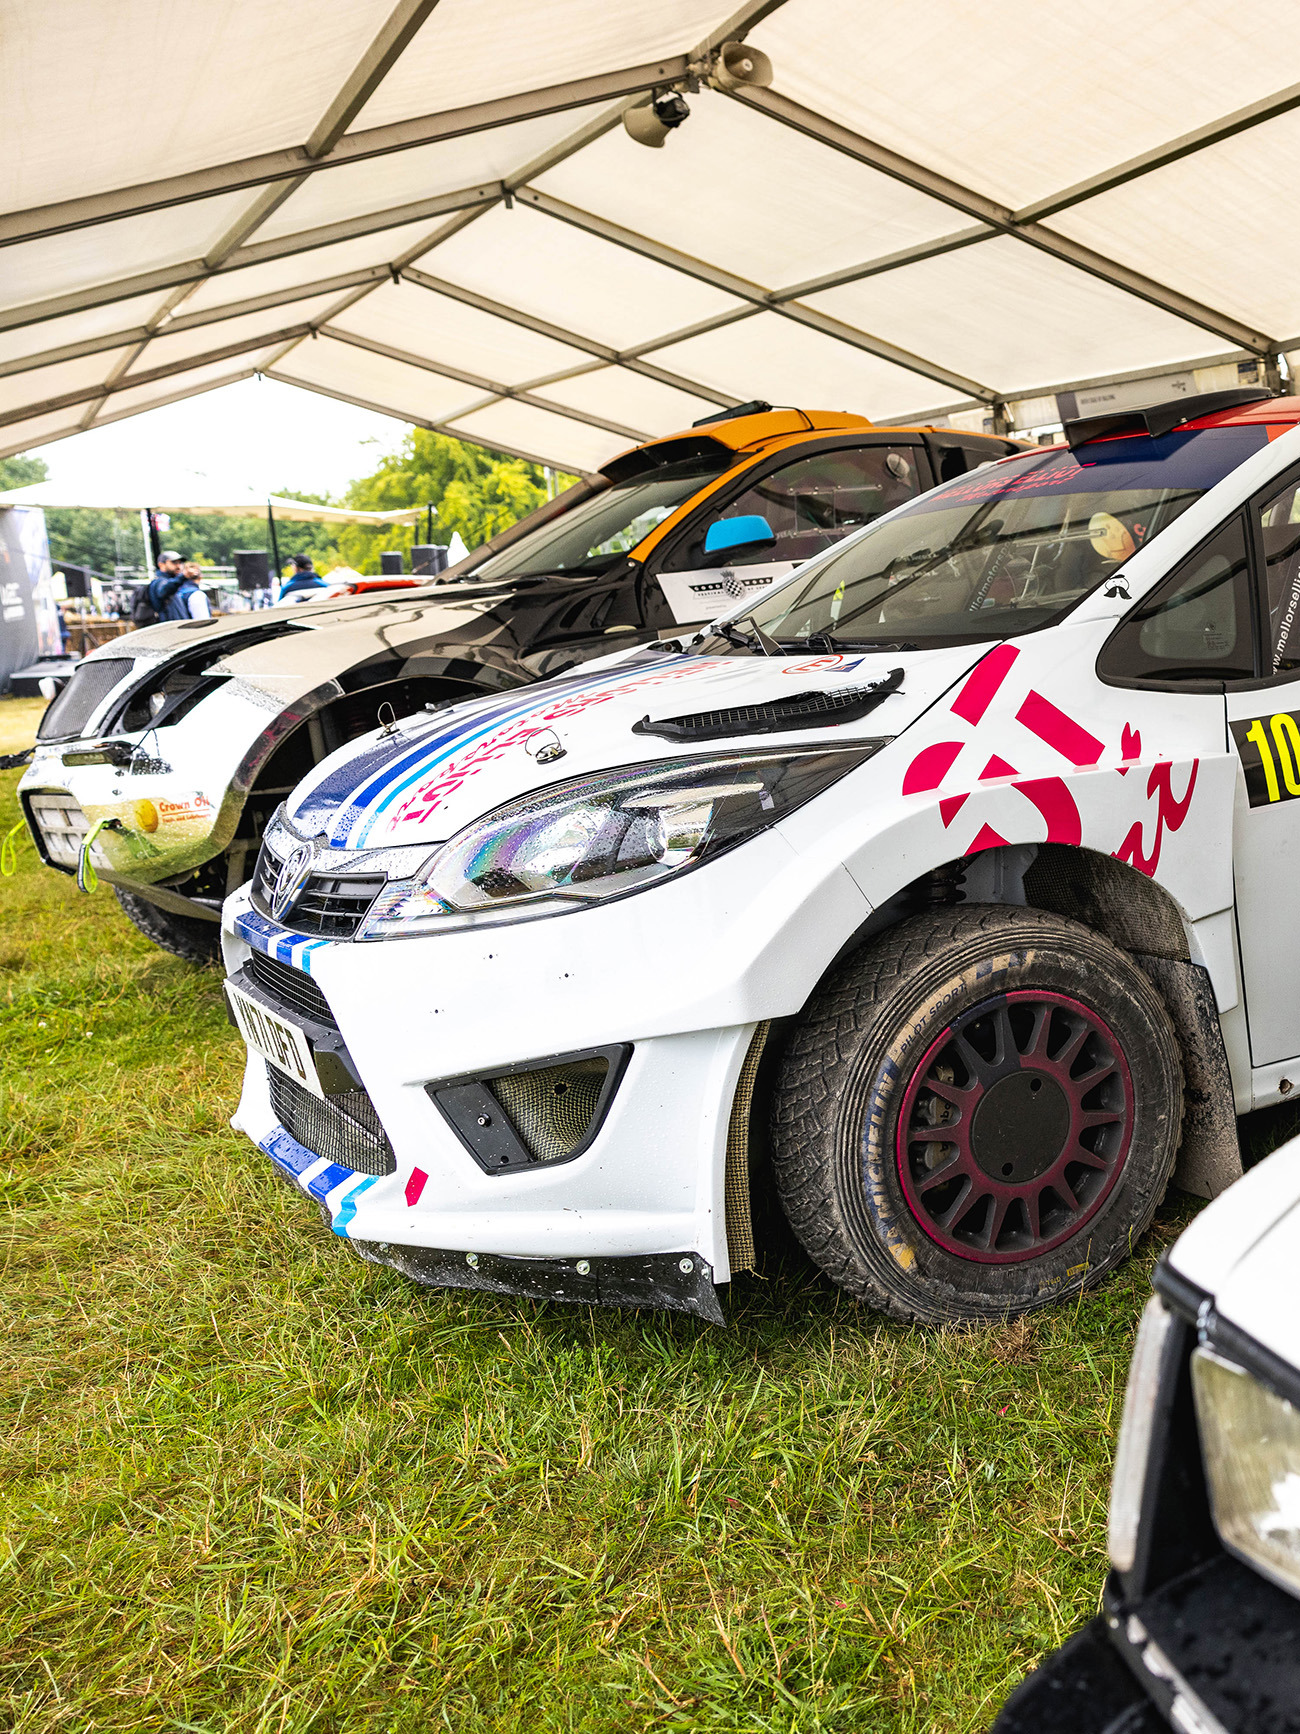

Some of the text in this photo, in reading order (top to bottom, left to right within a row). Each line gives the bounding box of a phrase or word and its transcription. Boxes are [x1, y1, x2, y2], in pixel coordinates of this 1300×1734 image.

[158, 800, 191, 812] Crown
[900, 981, 966, 1053] PILOT SPORT
[867, 1072, 896, 1220] MICHELIN
